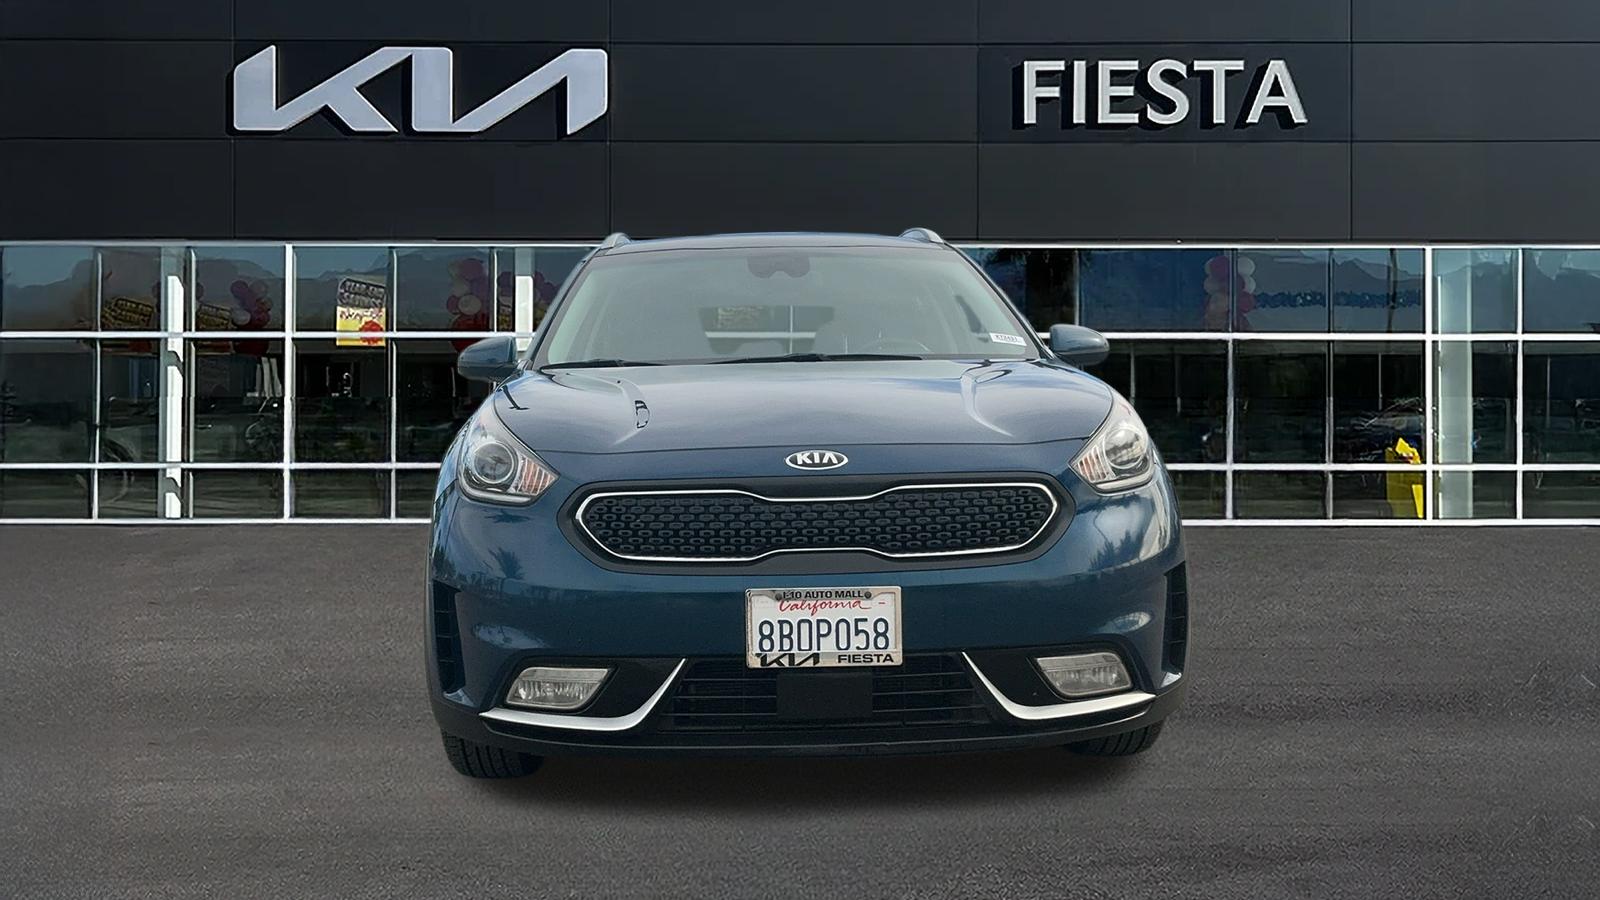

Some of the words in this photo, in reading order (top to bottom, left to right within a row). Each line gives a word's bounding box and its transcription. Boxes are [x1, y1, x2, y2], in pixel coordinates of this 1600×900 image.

[233, 45, 607, 134] KIA
[1023, 59, 1308, 124] FIESTA
[796, 452, 838, 464] KIA
[804, 590, 833, 599] AUTO
[835, 590, 863, 598] MALL
[779, 598, 871, 616] California
[755, 652, 820, 666] KIA
[837, 653, 894, 663] FIESTA
